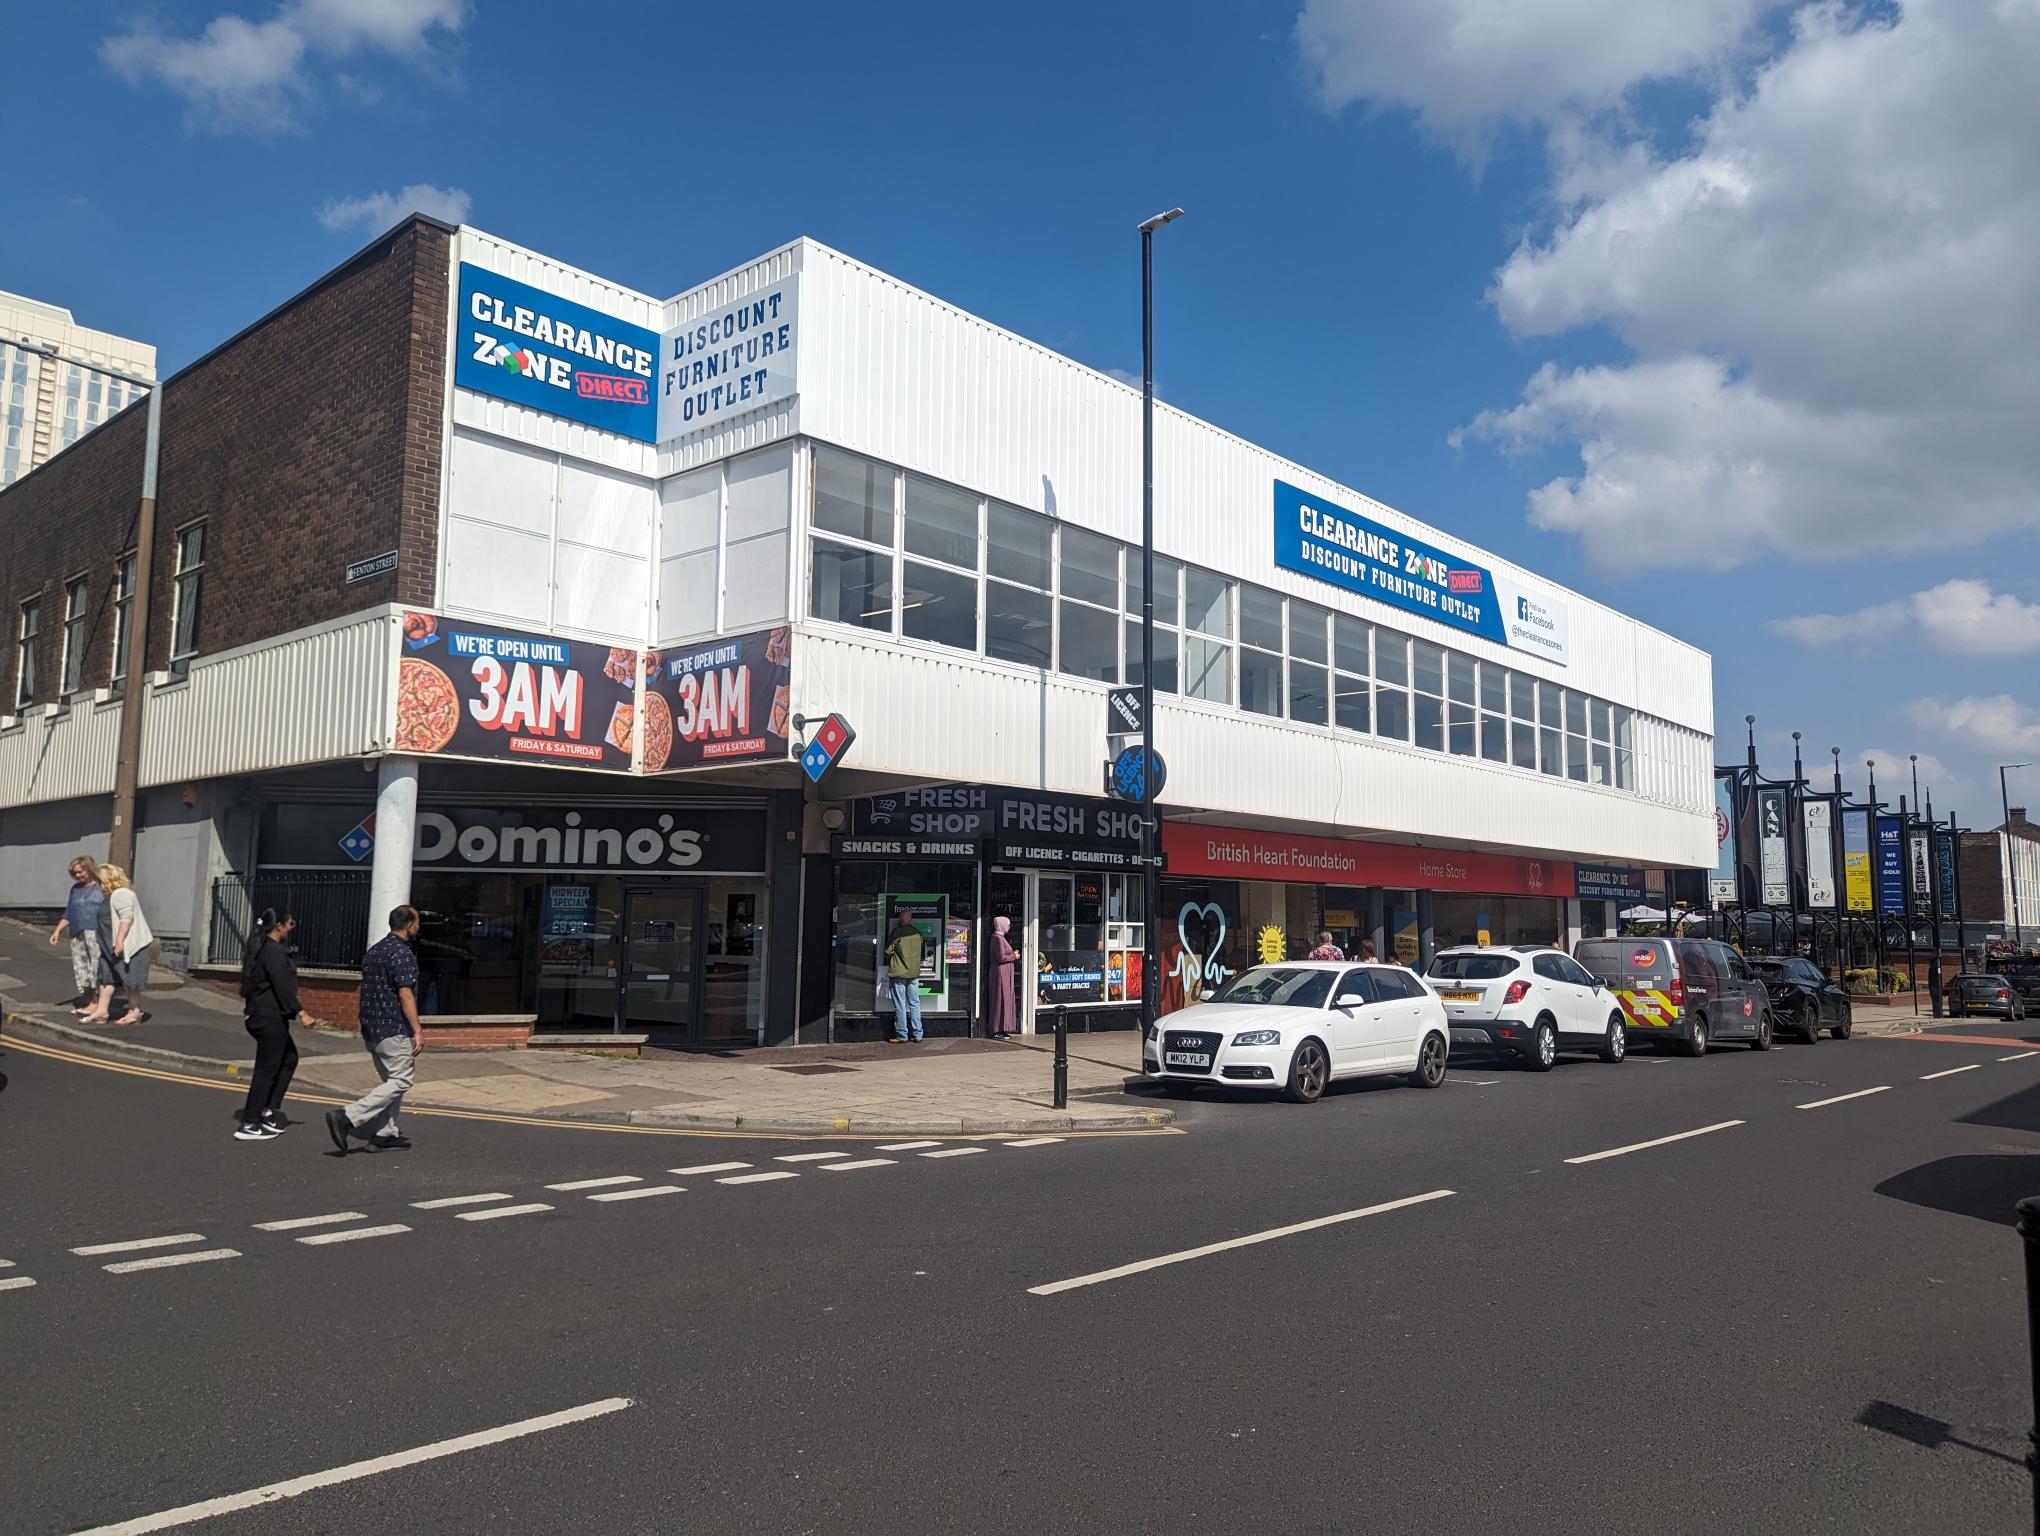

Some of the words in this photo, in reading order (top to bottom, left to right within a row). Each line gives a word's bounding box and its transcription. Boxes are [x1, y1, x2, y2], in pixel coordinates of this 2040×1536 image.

[471, 292, 653, 378] CLEARANCE
[674, 292, 782, 360] DISCOUNT
[665, 324, 791, 397] FURNITURE
[578, 377, 645, 401] DIRECT
[683, 369, 768, 422] OUTLET
[1300, 504, 1399, 568] CLEARANCE
[1452, 574, 1481, 590] DIRECT
[353, 562, 376, 578] FENTON
[376, 555, 397, 571] STREET
[1301, 540, 1367, 581] DISCOUNT
[1371, 567, 1437, 607] FURNITURE
[1441, 595, 1481, 624] OUTLET
[1529, 611, 1555, 631] Facebook
[455, 634, 496, 656] WE'RE
[497, 638, 529, 659] OPEN
[530, 641, 565, 662] UNTIL
[670, 656, 693, 676] WE'RE
[693, 652, 714, 672] OPEN
[715, 645, 738, 668] UNTIL
[469, 655, 582, 736] 3AM
[677, 665, 749, 737] 3AM
[1125, 692, 1141, 711] OFF
[1110, 693, 1140, 730] LICENCE
[512, 738, 546, 752] FRIDAY
[545, 741, 553, 752] &
[554, 743, 601, 757] SATURDAY
[703, 743, 726, 755] FRIDAY
[725, 743, 732, 753] &
[731, 738, 765, 753] SATURDAY
[1114, 750, 1133, 777] OFF
[904, 788, 986, 809] FRESH
[910, 813, 980, 835] SHOP
[1002, 800, 1084, 835] FRESH
[412, 811, 703, 867] Domino's
[1881, 831, 1899, 839] H&T
[842, 841, 901, 853] SNACKS
[906, 842, 916, 853] &
[921, 843, 974, 855] DRINKS
[1006, 846, 1023, 857] OFF
[1025, 847, 1063, 860] LICENCE
[1071, 850, 1124, 864] CIGARETTES
[1207, 840, 1250, 862] British
[1253, 845, 1289, 866] Heart
[1291, 848, 1356, 871] Foundation
[1419, 861, 1444, 878] Home
[1445, 863, 1467, 879] Store
[1578, 870, 1611, 884] CLEARANCE
[551, 886, 590, 898] MIDWEEK
[552, 897, 587, 908] SPECIAL
[1579, 885, 1600, 895] DISCOUNT
[1601, 887, 1624, 896] FURNITURE
[1625, 889, 1641, 897] OUTLET
[1107, 969, 1121, 979] 24/7
[1170, 1053, 1187, 1063] MK12
[1189, 1055, 1205, 1064] YLP
